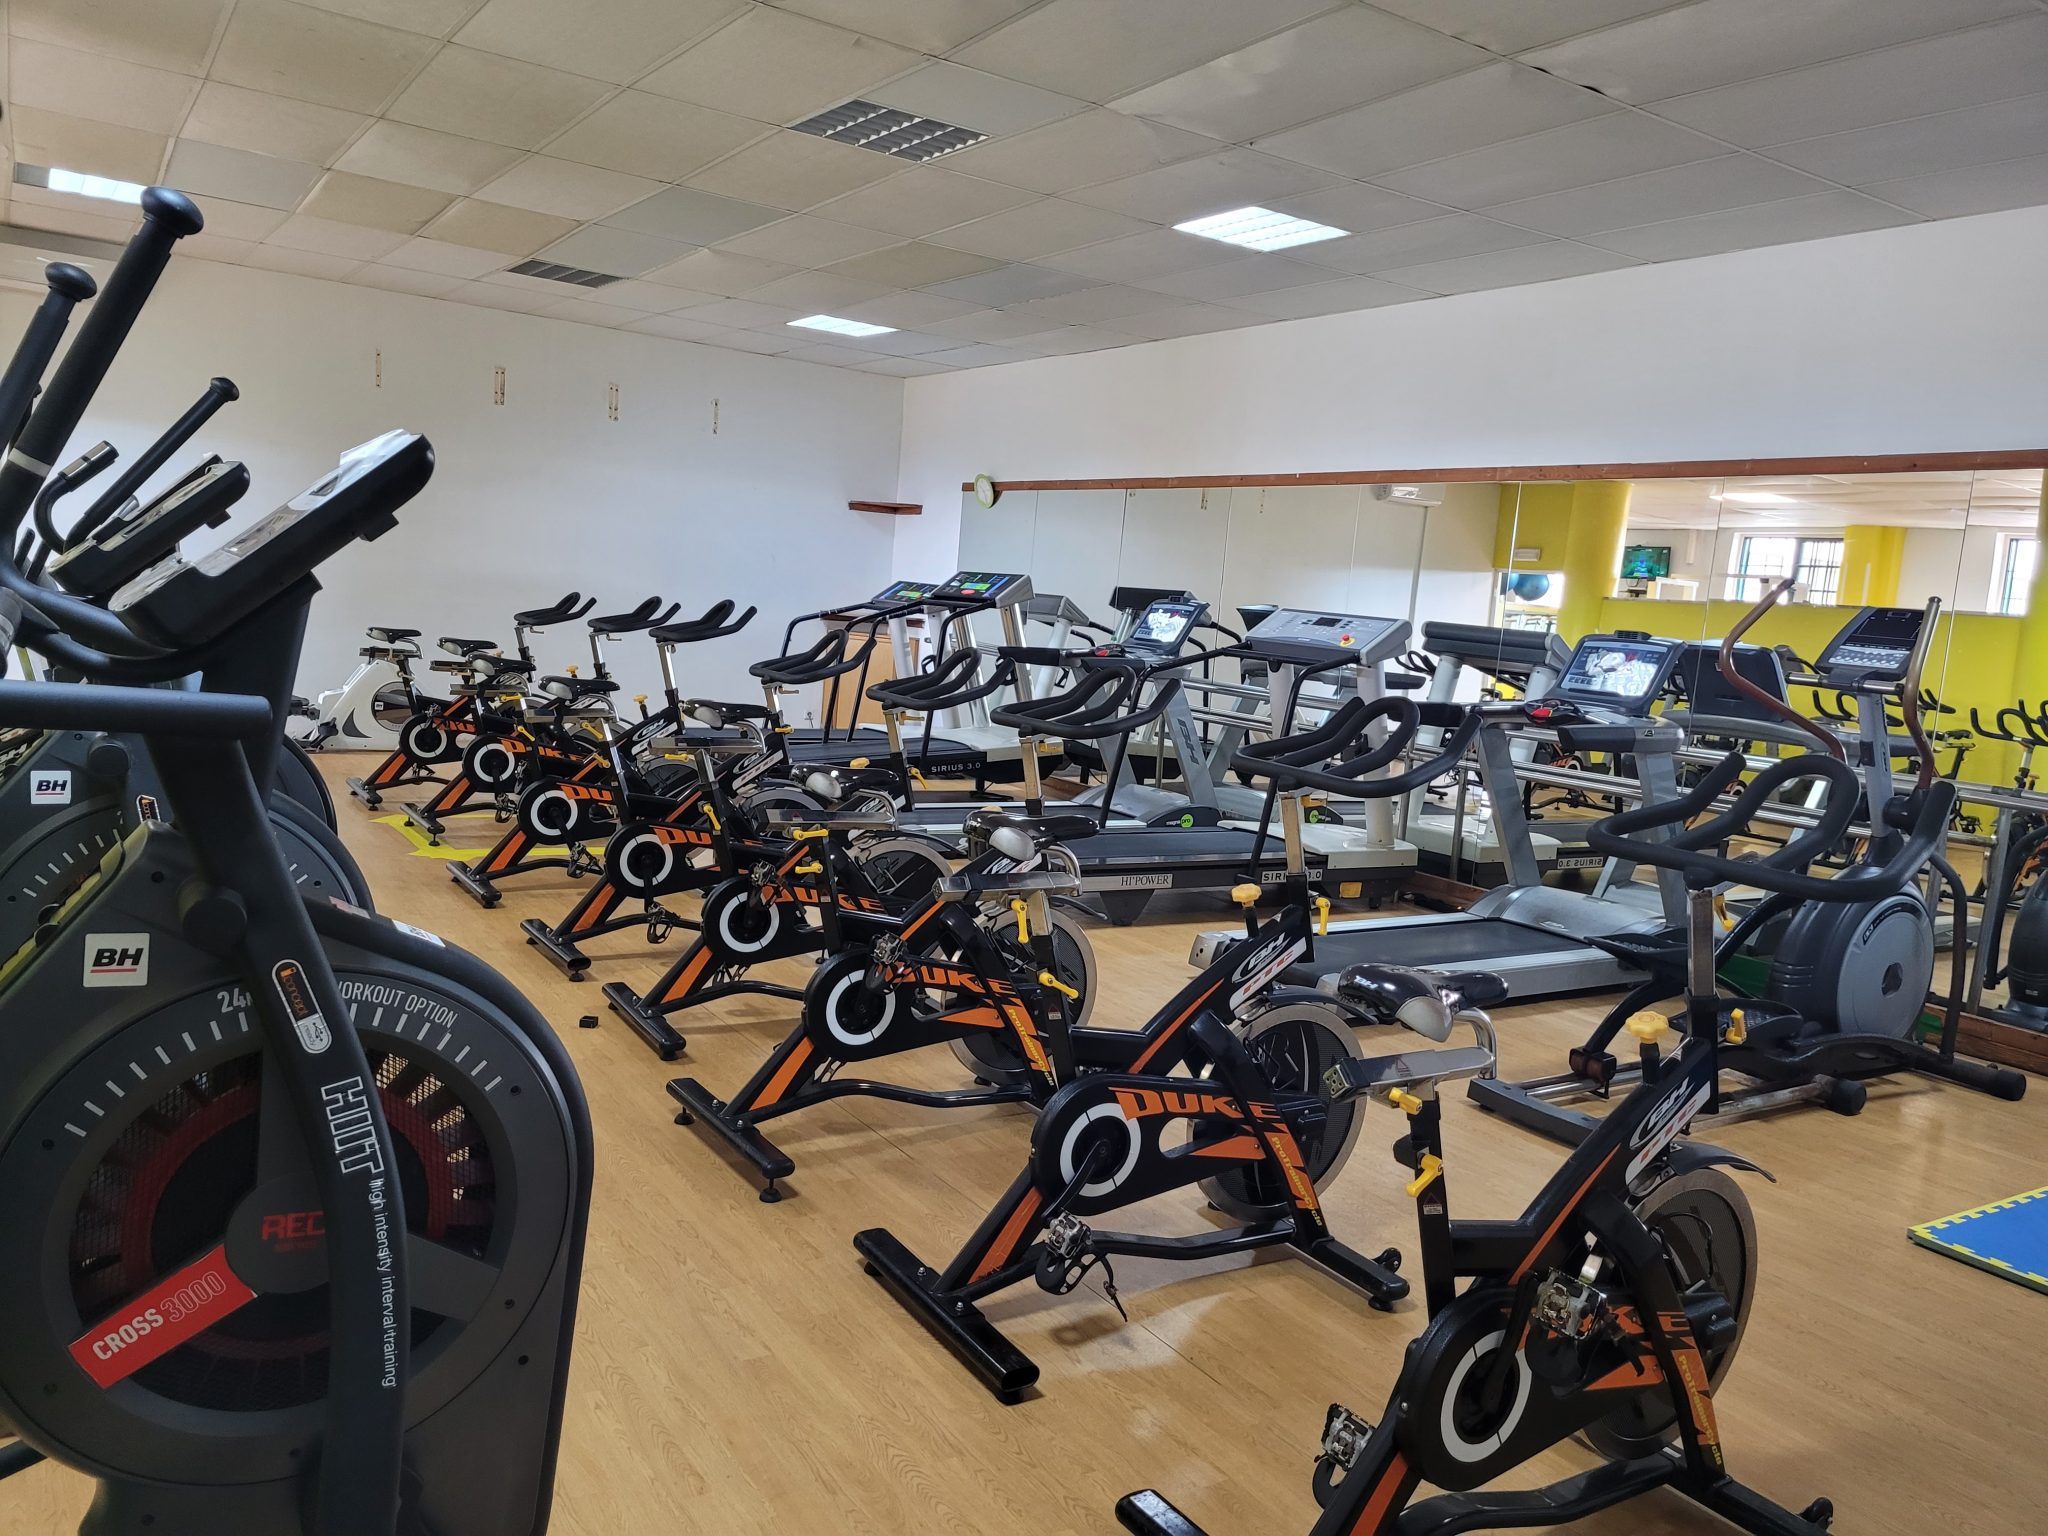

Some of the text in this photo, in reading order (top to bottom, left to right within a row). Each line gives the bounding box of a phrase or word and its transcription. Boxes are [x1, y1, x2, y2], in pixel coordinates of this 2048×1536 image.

[36, 779, 68, 791] BH
[931, 762, 981, 773] SIRIUS 3.0
[1263, 872, 1286, 882] SIRI
[92, 947, 144, 967] BH
[1247, 931, 1286, 971] BH
[405, 993, 459, 1029] OPTION
[1108, 1086, 1281, 1121] DUKE
[321, 1076, 385, 1174] HIIT
[368, 1178, 398, 1389] high intensity interval training
[92, 1270, 227, 1361] CROSS 3000
